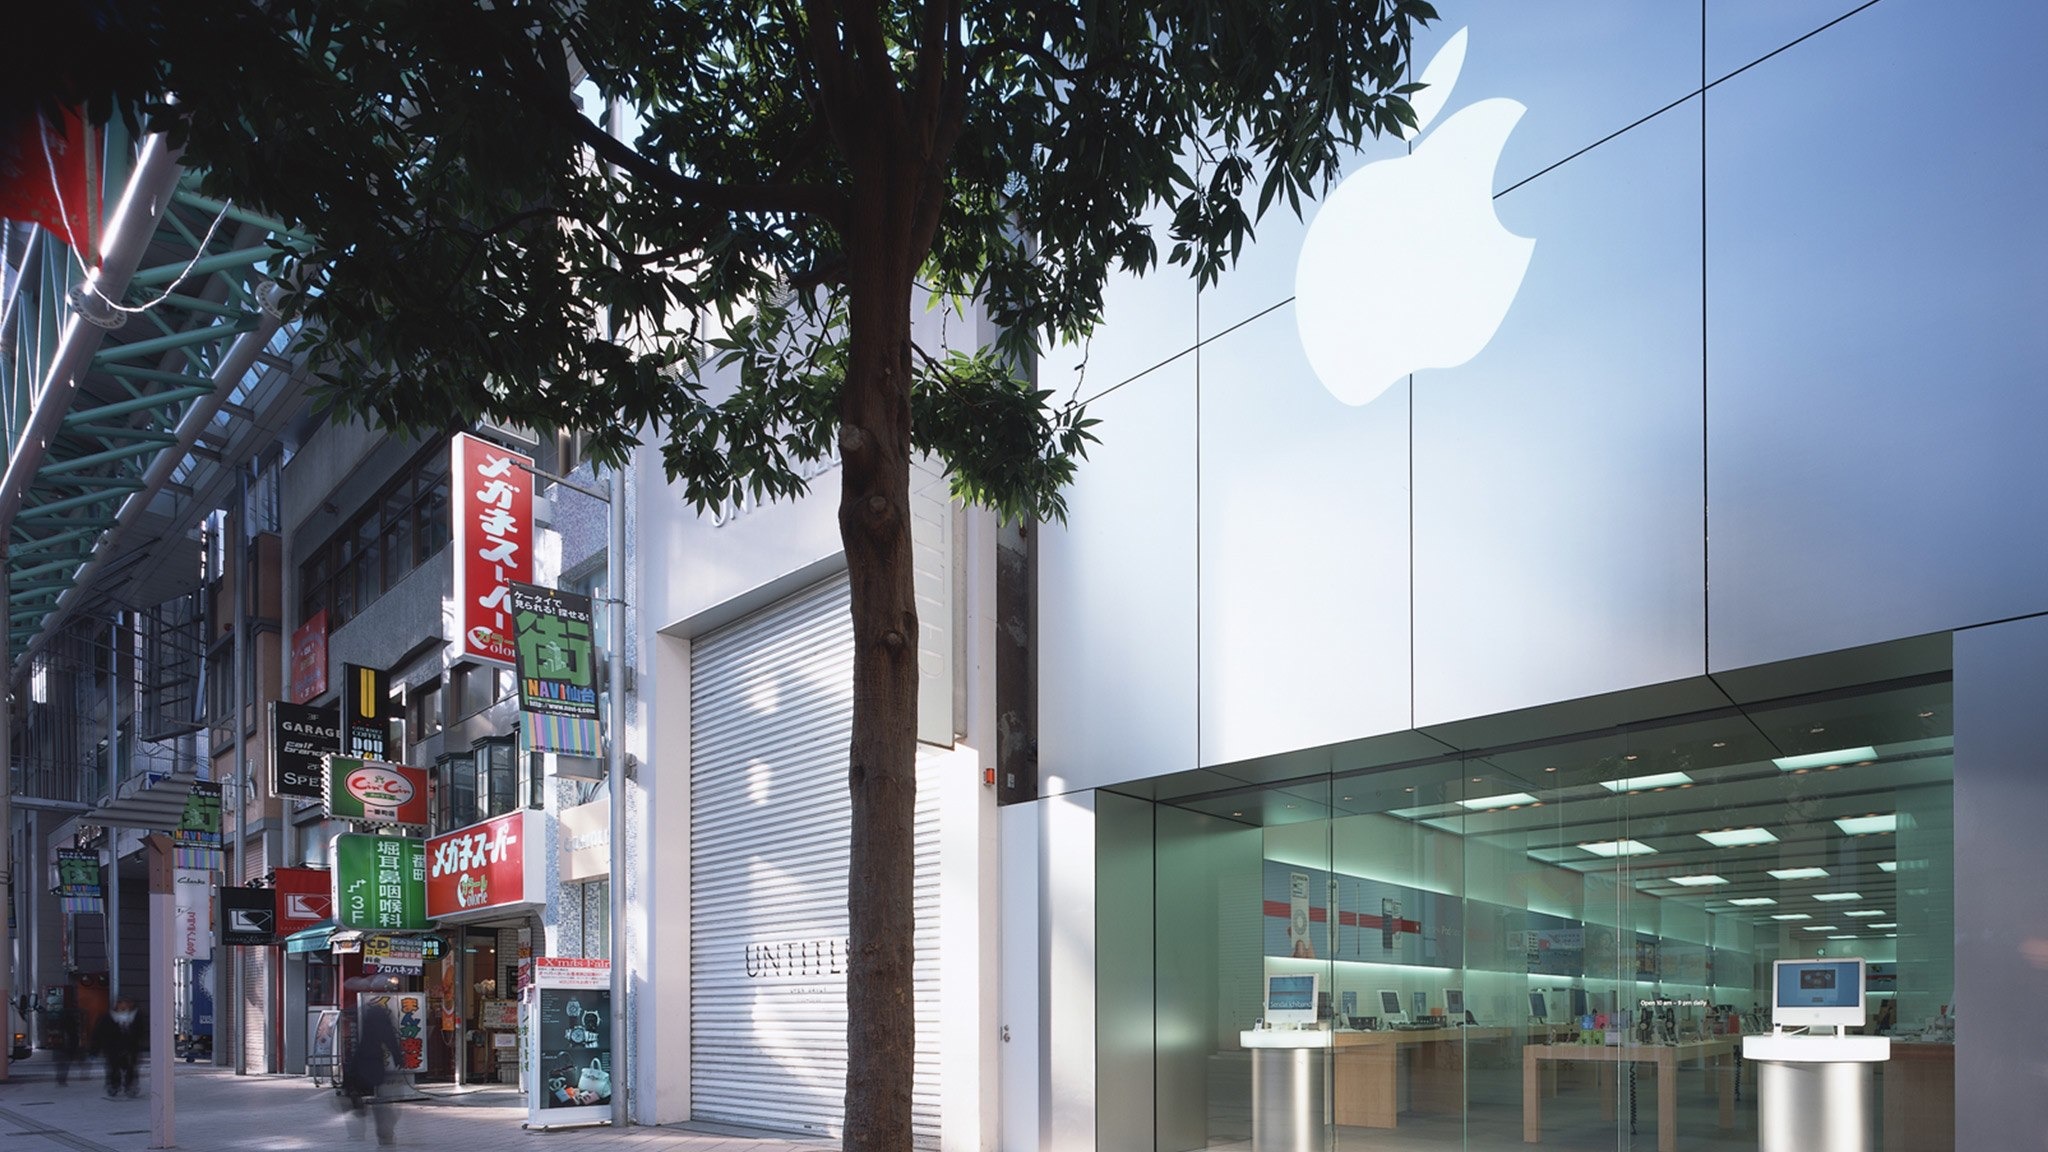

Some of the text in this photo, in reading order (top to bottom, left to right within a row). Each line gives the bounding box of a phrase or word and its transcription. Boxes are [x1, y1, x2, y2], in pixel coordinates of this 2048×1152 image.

[514, 591, 562, 607] ケータイで
[515, 610, 592, 686] 街
[432, 823, 517, 878] メガネスーパー
[745, 939, 849, 977] UNTITL
